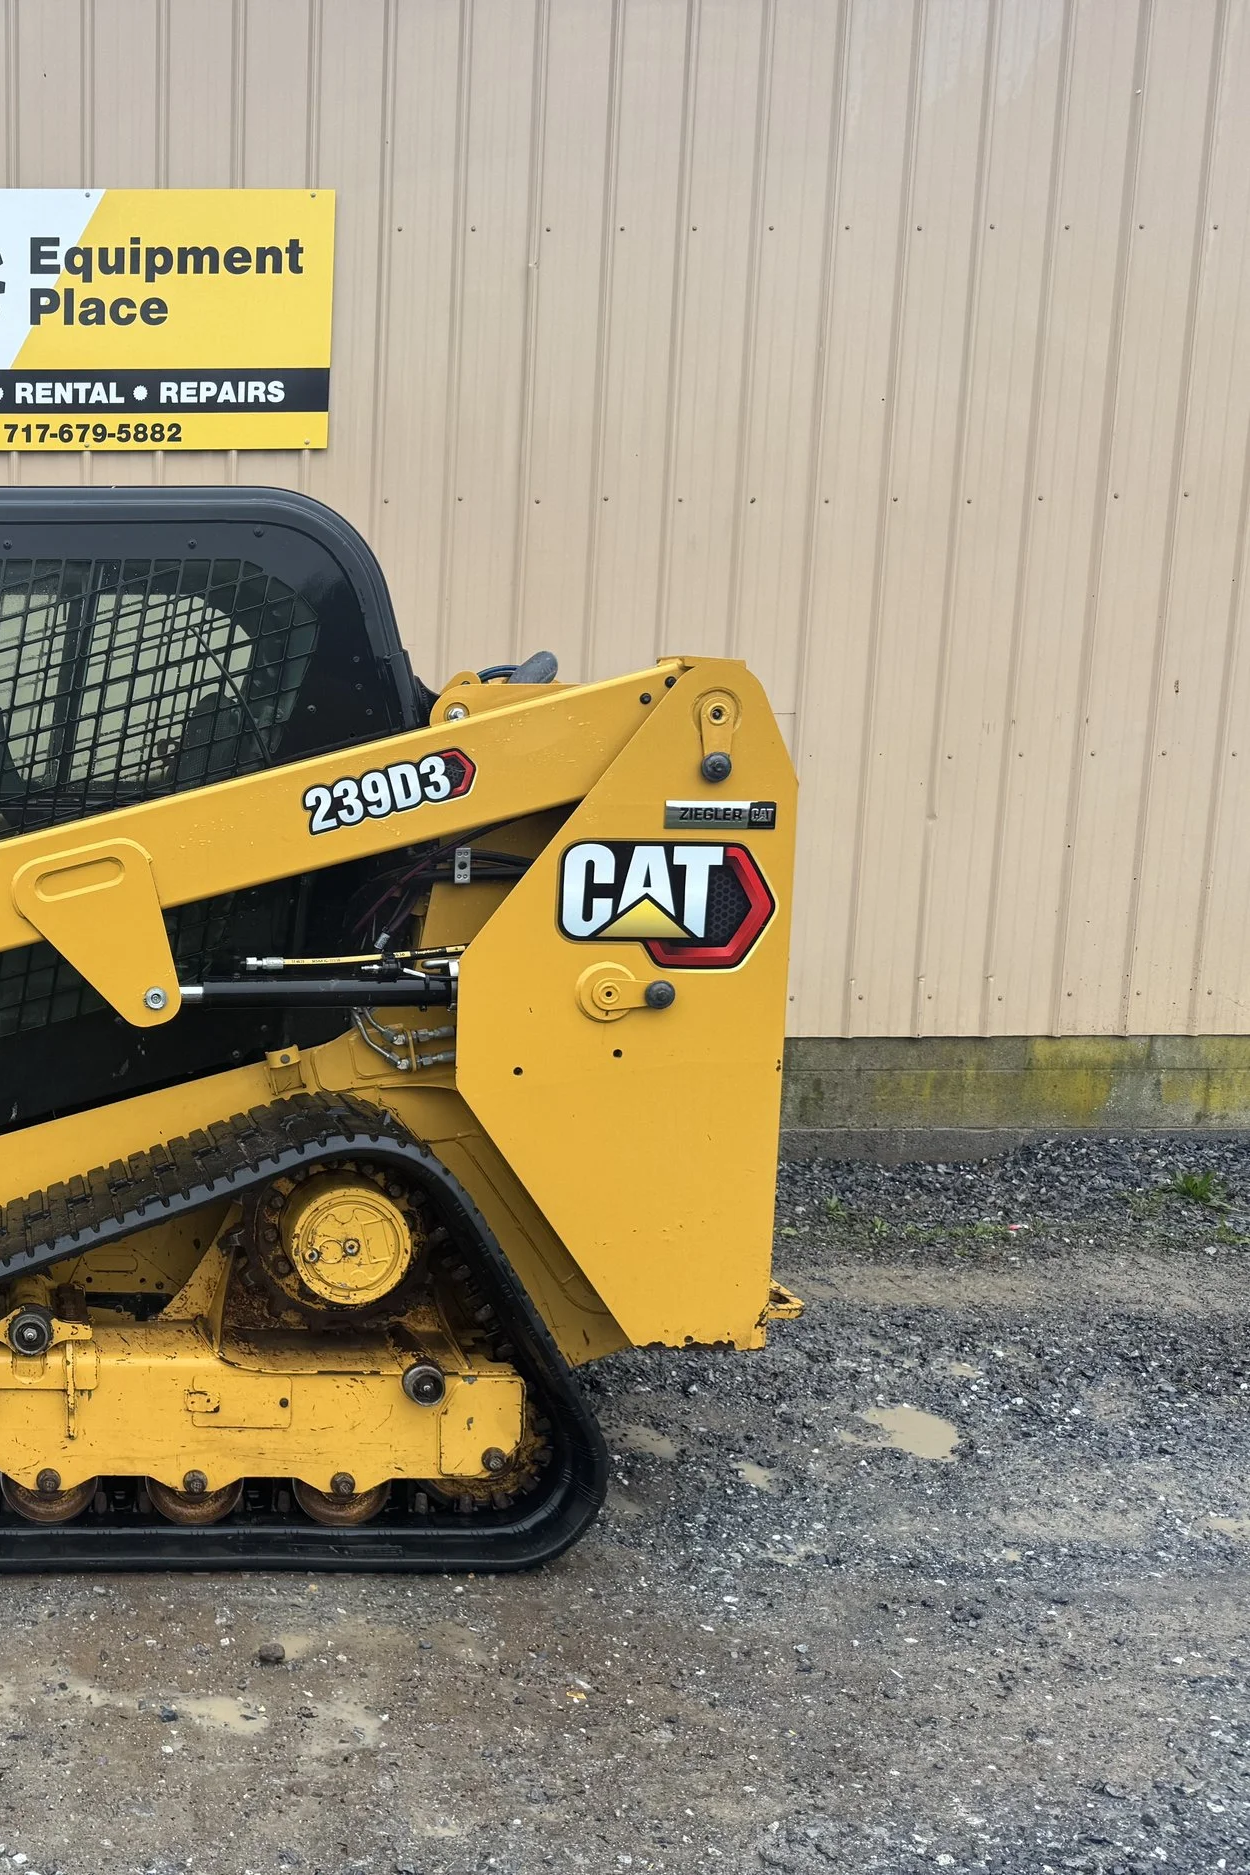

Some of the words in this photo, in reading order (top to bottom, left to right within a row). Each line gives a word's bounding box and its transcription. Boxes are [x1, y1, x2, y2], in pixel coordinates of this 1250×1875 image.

[30, 236, 304, 283] Equipment
[30, 288, 168, 326] Place
[15, 382, 125, 404] RENTAL
[159, 381, 286, 403] REPAIRS
[4, 423, 182, 443] 717-679-5882
[305, 756, 451, 832] 239D3
[679, 807, 742, 821] ZIEGLER
[751, 808, 774, 822] CAT
[562, 843, 724, 938] CAT
